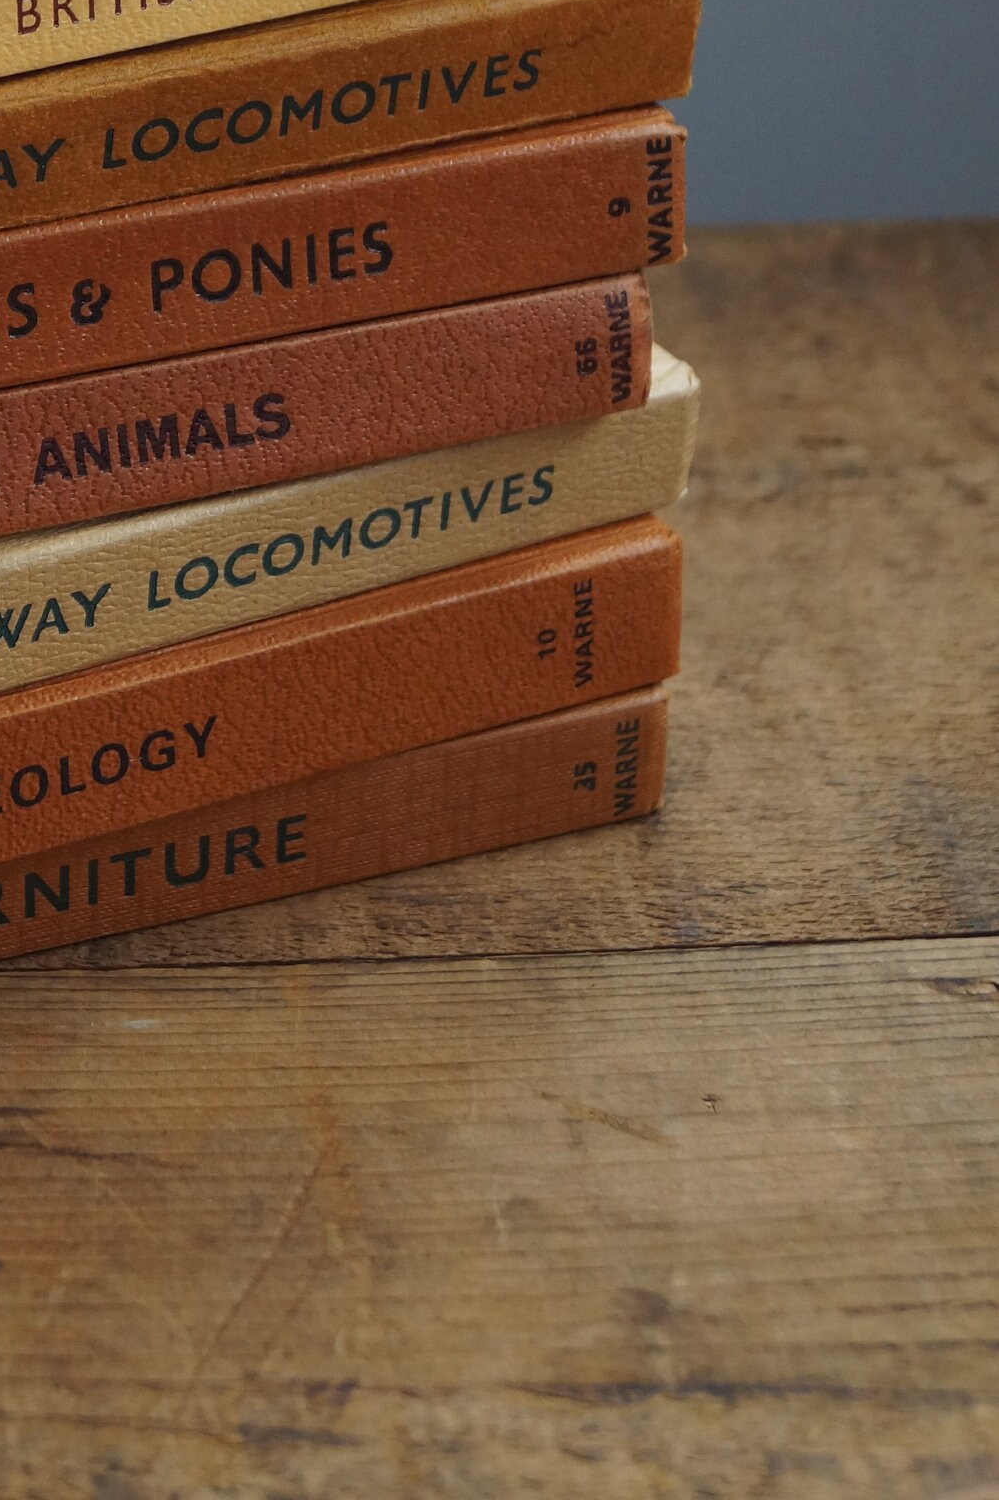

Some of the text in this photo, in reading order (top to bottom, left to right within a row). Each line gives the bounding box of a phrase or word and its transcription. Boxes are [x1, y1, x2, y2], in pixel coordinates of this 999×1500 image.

[101, 48, 543, 170] LOCOMOTIVES
[607, 196, 631, 218] 9
[645, 135, 674, 265] WARNE
[70, 279, 112, 327] &
[151, 220, 394, 313] PONIES
[604, 288, 633, 405] WARNE
[33, 393, 292, 486] ANIMALS
[147, 464, 558, 612] LOCOMOTIVES
[537, 628, 558, 661] 10
[573, 577, 594, 689] WARNE
[612, 716, 641, 818] WARNE
